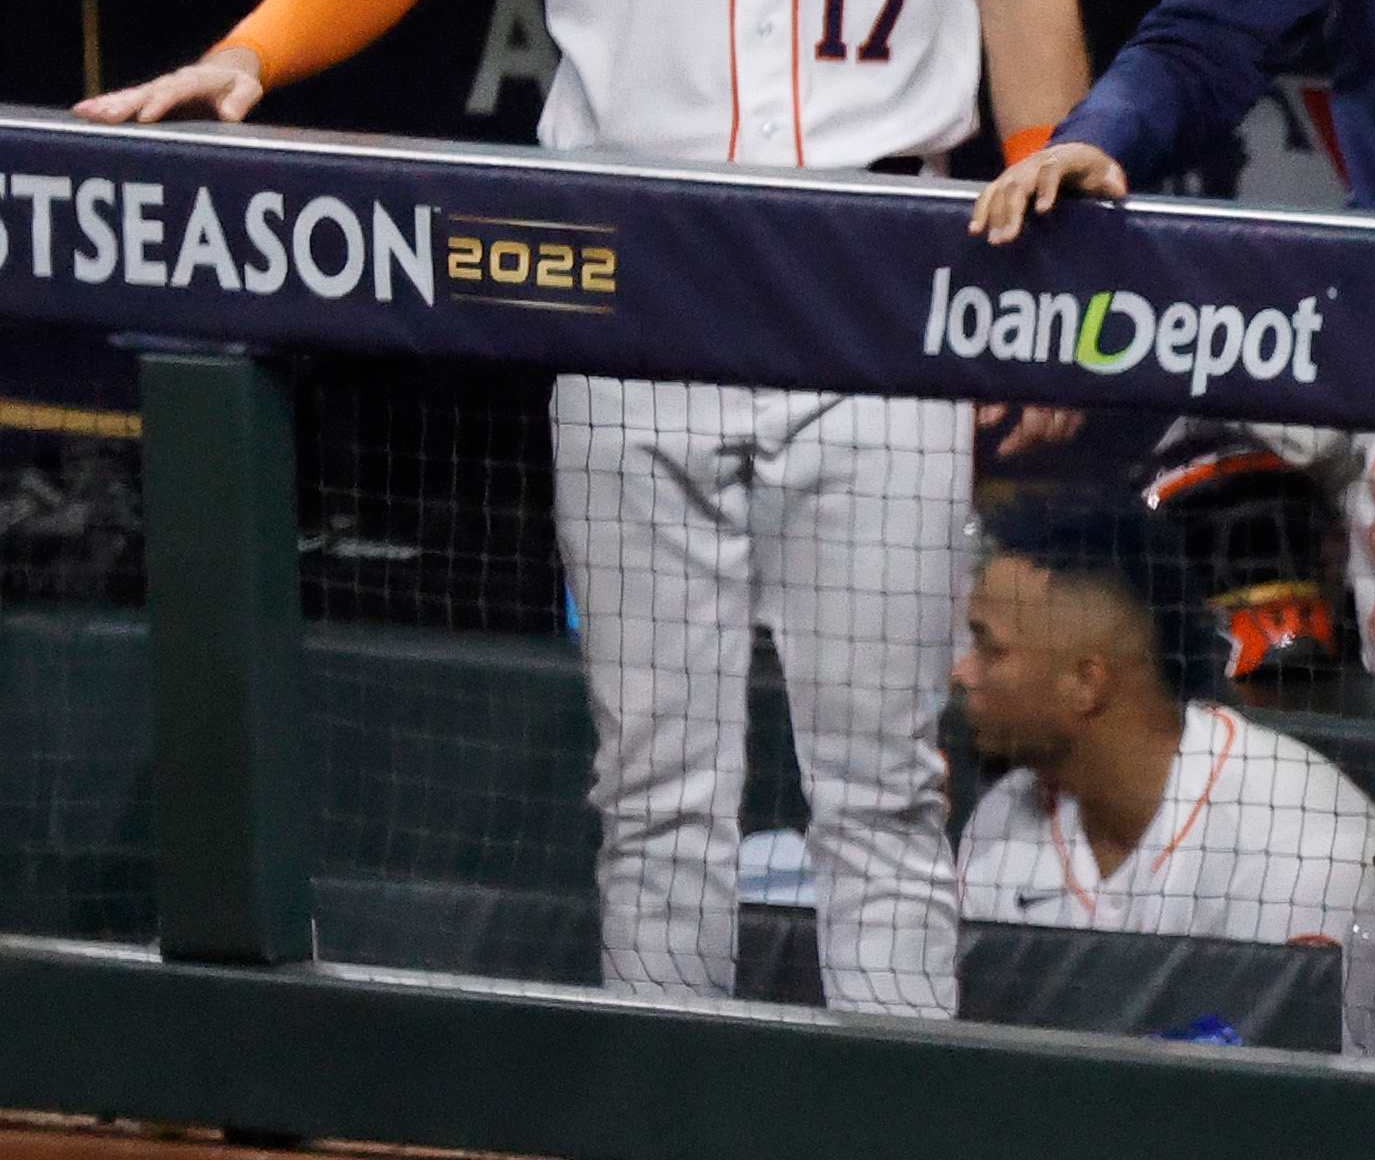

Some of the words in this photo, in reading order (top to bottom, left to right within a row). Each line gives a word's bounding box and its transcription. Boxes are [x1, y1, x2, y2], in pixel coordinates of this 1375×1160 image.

[0, 173, 436, 308] TSEASON
[447, 235, 617, 293] 2022
[923, 266, 1324, 397] loanDepot
